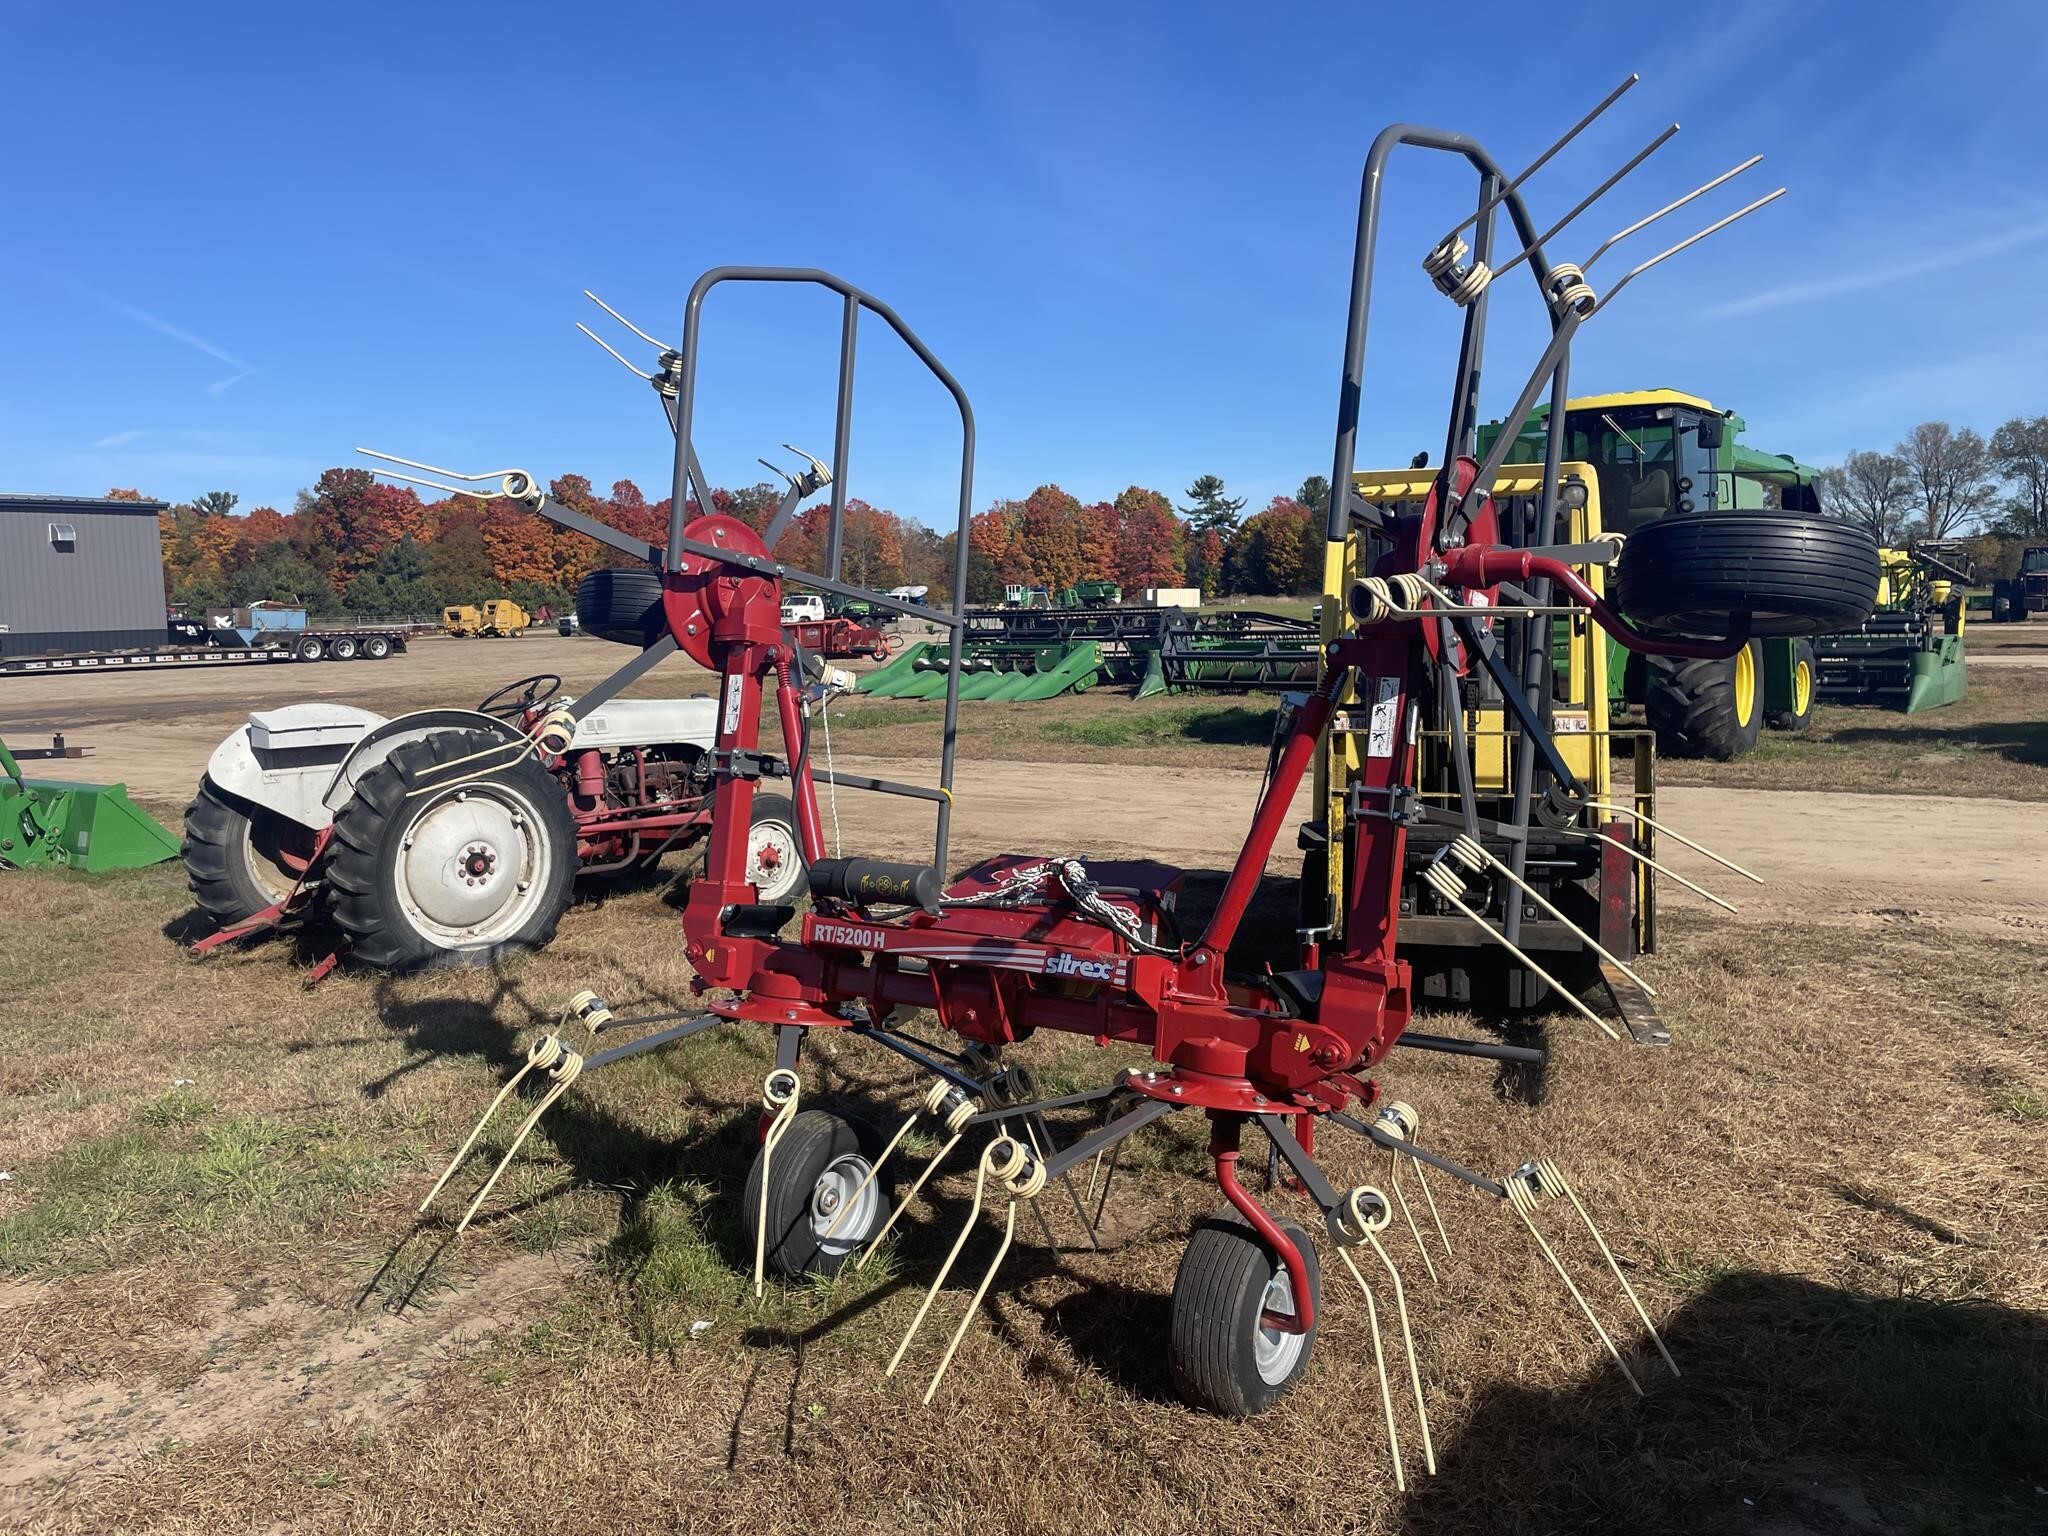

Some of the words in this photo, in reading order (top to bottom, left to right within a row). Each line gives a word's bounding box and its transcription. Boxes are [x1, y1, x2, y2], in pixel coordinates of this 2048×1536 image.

[815, 924, 872, 947] RT/5200
[873, 931, 885, 949] H
[1045, 952, 1114, 980] sitrex
